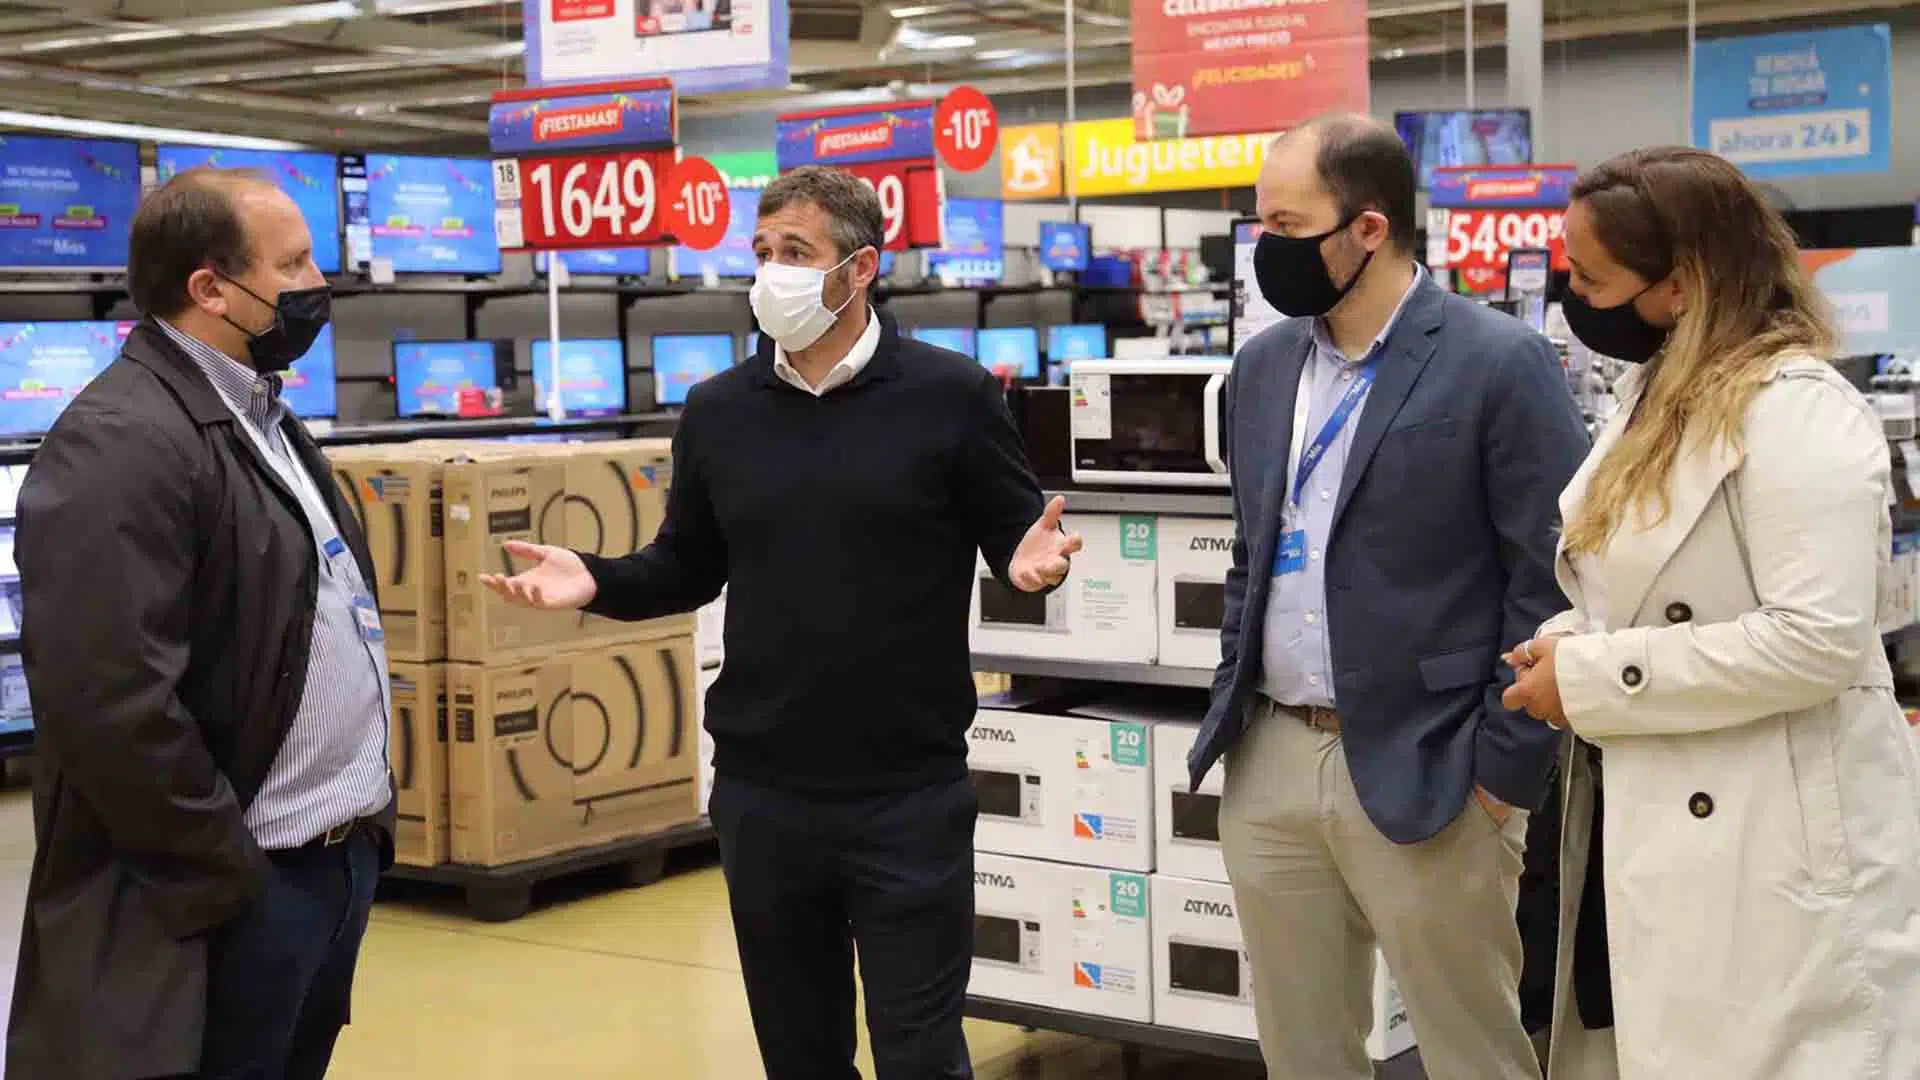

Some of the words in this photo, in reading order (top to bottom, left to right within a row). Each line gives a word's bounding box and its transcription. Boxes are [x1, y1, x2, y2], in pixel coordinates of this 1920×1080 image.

[538, 106, 619, 140] ¡FIESTAMAS!
[1801, 123, 1838, 148] 24
[530, 157, 656, 237] 1649
[1124, 522, 1150, 538] 20
[971, 726, 1016, 743] ATMA
[1116, 729, 1140, 747] 20
[1115, 879, 1140, 897] 20
[1183, 898, 1234, 918] ATMA
